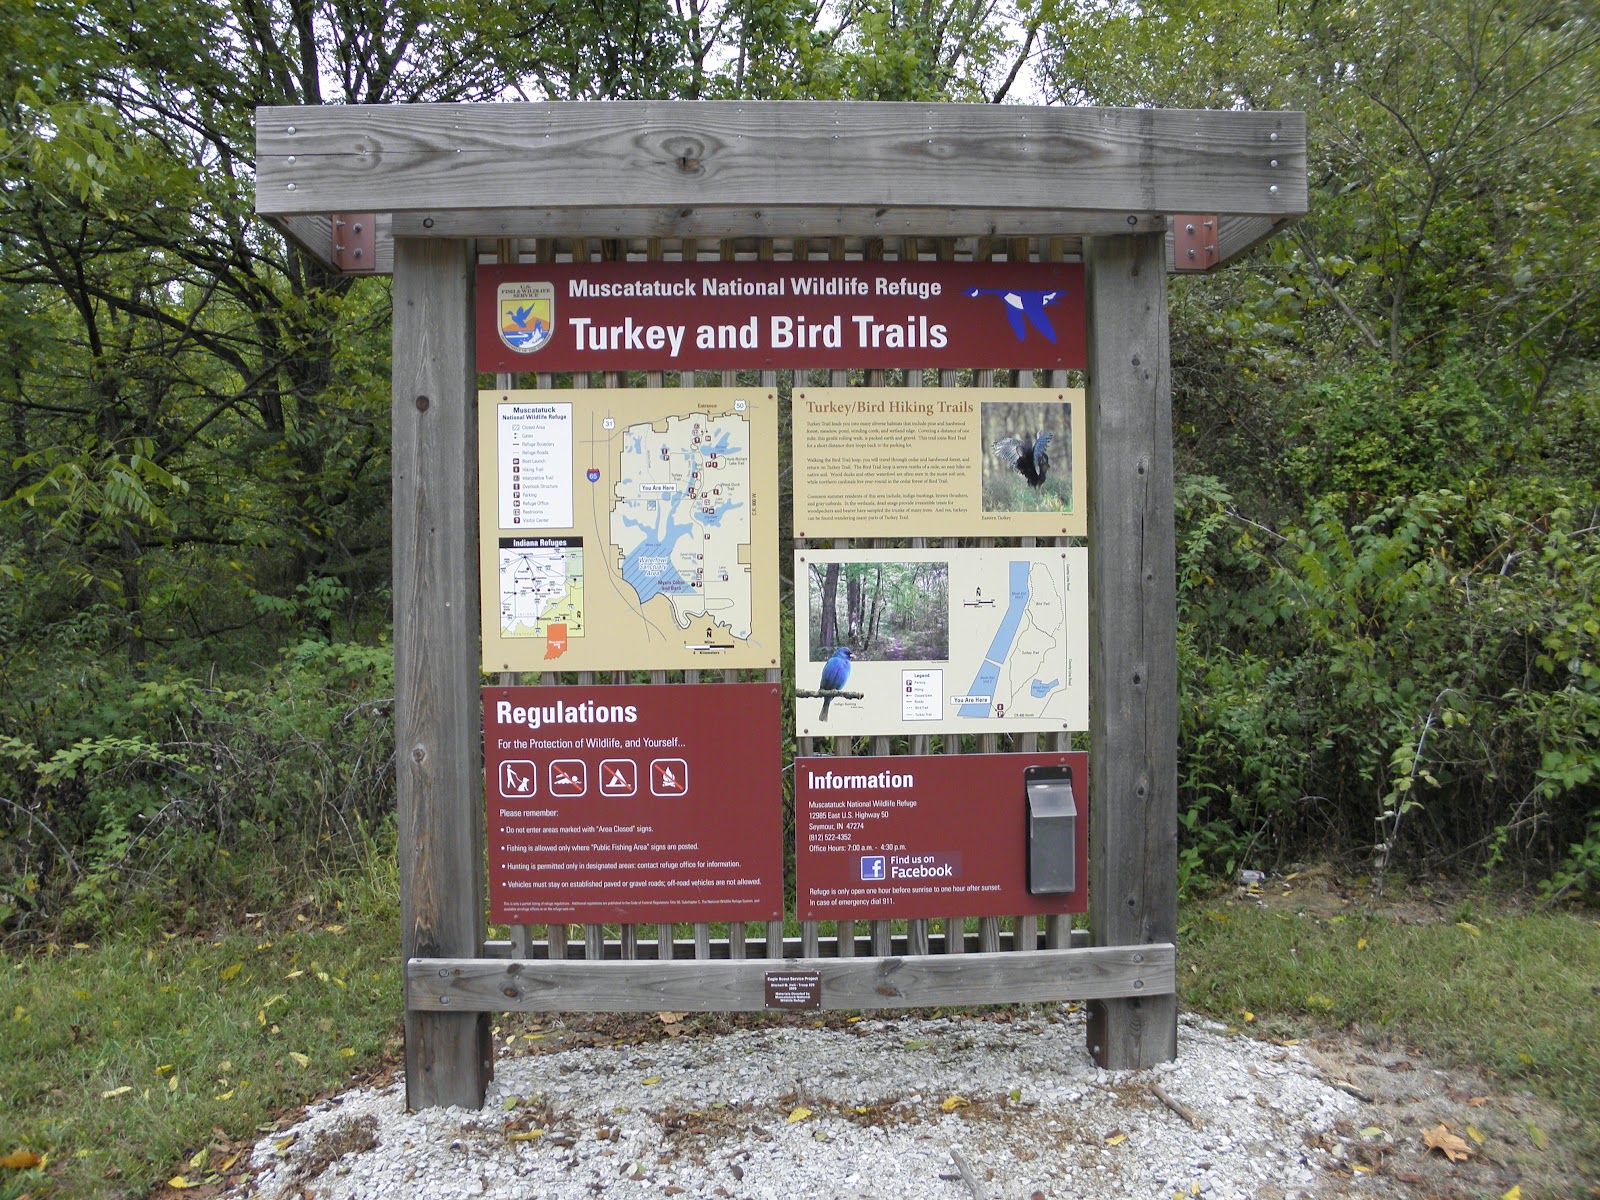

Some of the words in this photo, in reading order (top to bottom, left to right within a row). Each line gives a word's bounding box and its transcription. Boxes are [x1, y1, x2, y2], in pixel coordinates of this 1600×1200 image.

[569, 278, 696, 297] Muscatatuck
[702, 278, 784, 296] National
[791, 277, 869, 295] Wildlife
[875, 277, 942, 300] Refuge
[569, 317, 686, 357] Turkey
[696, 316, 758, 349] and
[771, 315, 842, 348] Bird
[852, 315, 948, 348] Trails
[806, 401, 885, 416] Turkey/Bird
[889, 401, 934, 417] Hiking
[937, 401, 974, 413] Trails
[513, 539, 538, 547] Indiana
[540, 538, 567, 547] Refuges
[497, 700, 638, 729] Regulations
[498, 738, 512, 749] For
[514, 739, 528, 749] the
[530, 738, 573, 749] Protection
[575, 738, 584, 749] of
[586, 738, 623, 749] Wildlife,
[625, 738, 641, 748] and
[643, 737, 686, 748] Yourself...
[808, 771, 913, 789] Information
[897, 799, 917, 808] Refuge
[500, 808, 522, 818] Please
[523, 809, 559, 817] remember:
[809, 812, 827, 820] 12985
[855, 811, 880, 820] Highway
[881, 810, 889, 818] 50
[506, 826, 515, 834] Do
[637, 825, 654, 834] signs.
[809, 822, 835, 831] Seymour,
[809, 834, 824, 842] (812)
[507, 844, 527, 853] Fishing
[612, 844, 633, 852] Fishing
[678, 843, 699, 851] posted.
[809, 844, 827, 852] Office
[891, 855, 910, 864] Find
[507, 862, 530, 872] Hunting
[566, 862, 578, 871] only
[586, 862, 618, 871] designated
[660, 861, 679, 870] refuge
[892, 864, 952, 878] Facebook
[604, 880, 621, 888] paved
[629, 880, 647, 889] gravel
[810, 888, 830, 897] Refuge
[837, 888, 850, 896] only
